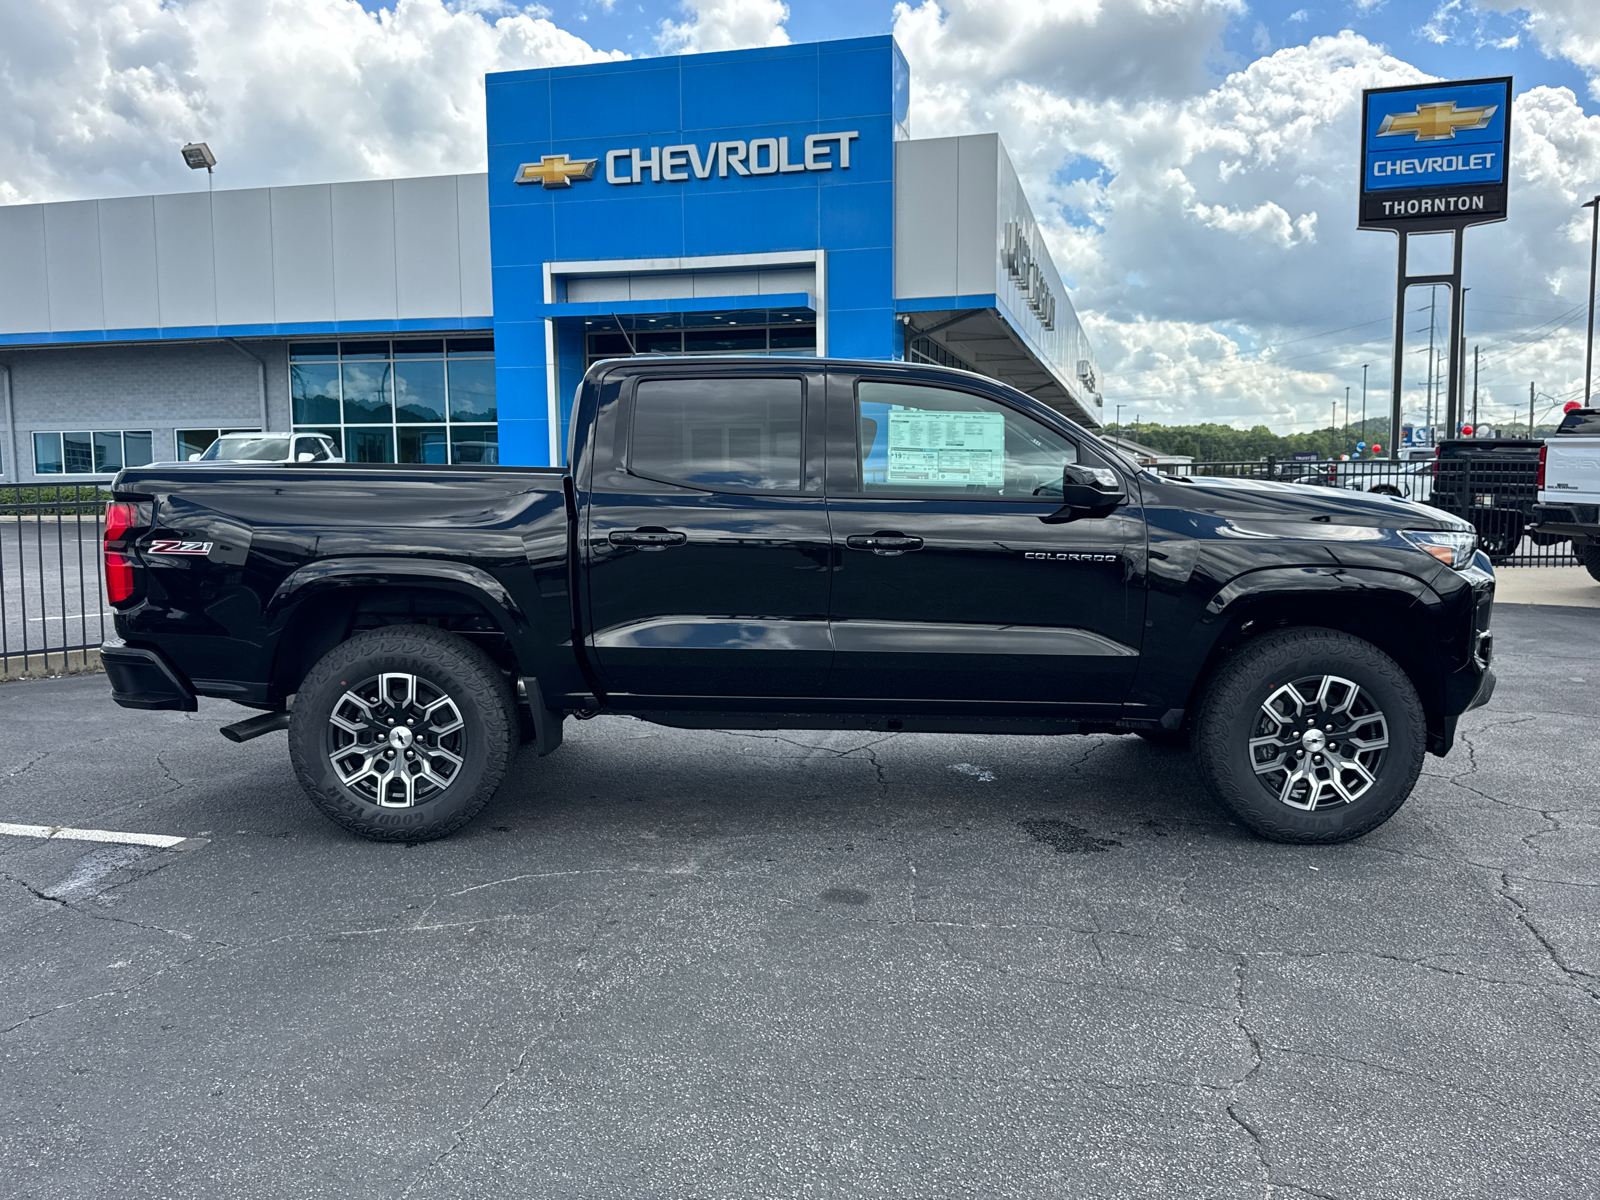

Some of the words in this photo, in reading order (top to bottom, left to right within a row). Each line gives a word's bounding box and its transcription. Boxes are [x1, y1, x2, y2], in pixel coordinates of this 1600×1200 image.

[605, 130, 860, 185] CHEVROLET
[1373, 153, 1496, 177] CHEVROLET
[1382, 195, 1484, 215] THORNTON
[147, 540, 214, 556] Z71
[1024, 552, 1117, 562] COLORADO
[368, 656, 464, 695] WRANGLER
